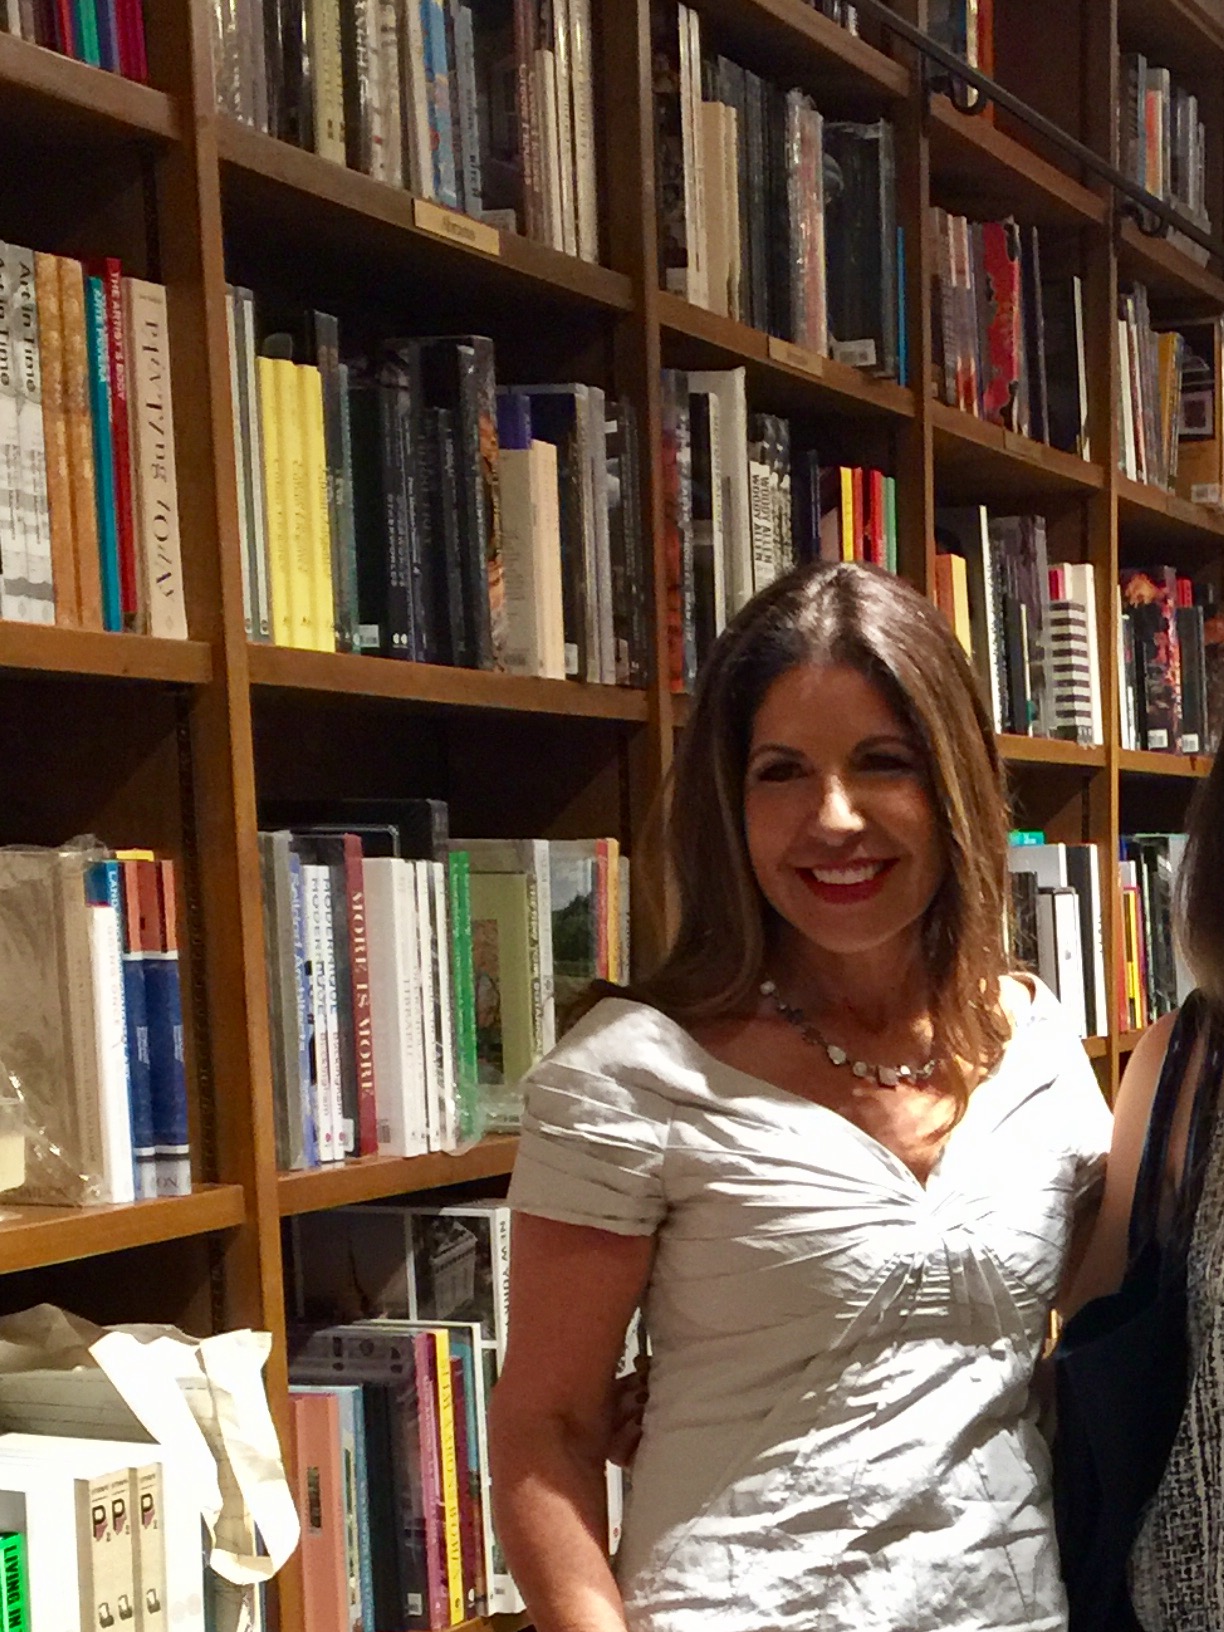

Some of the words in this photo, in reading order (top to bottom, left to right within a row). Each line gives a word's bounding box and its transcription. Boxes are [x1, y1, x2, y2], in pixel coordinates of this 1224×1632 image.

[19, 261, 33, 301] Art
[21, 308, 35, 328] in
[22, 337, 38, 393] Time
[352, 891, 367, 971] MORE
[356, 983, 369, 1008] IS
[358, 1017, 374, 1099] MORE
[3, 1544, 21, 1605] LIVING
[8, 1607, 22, 1628] IN
